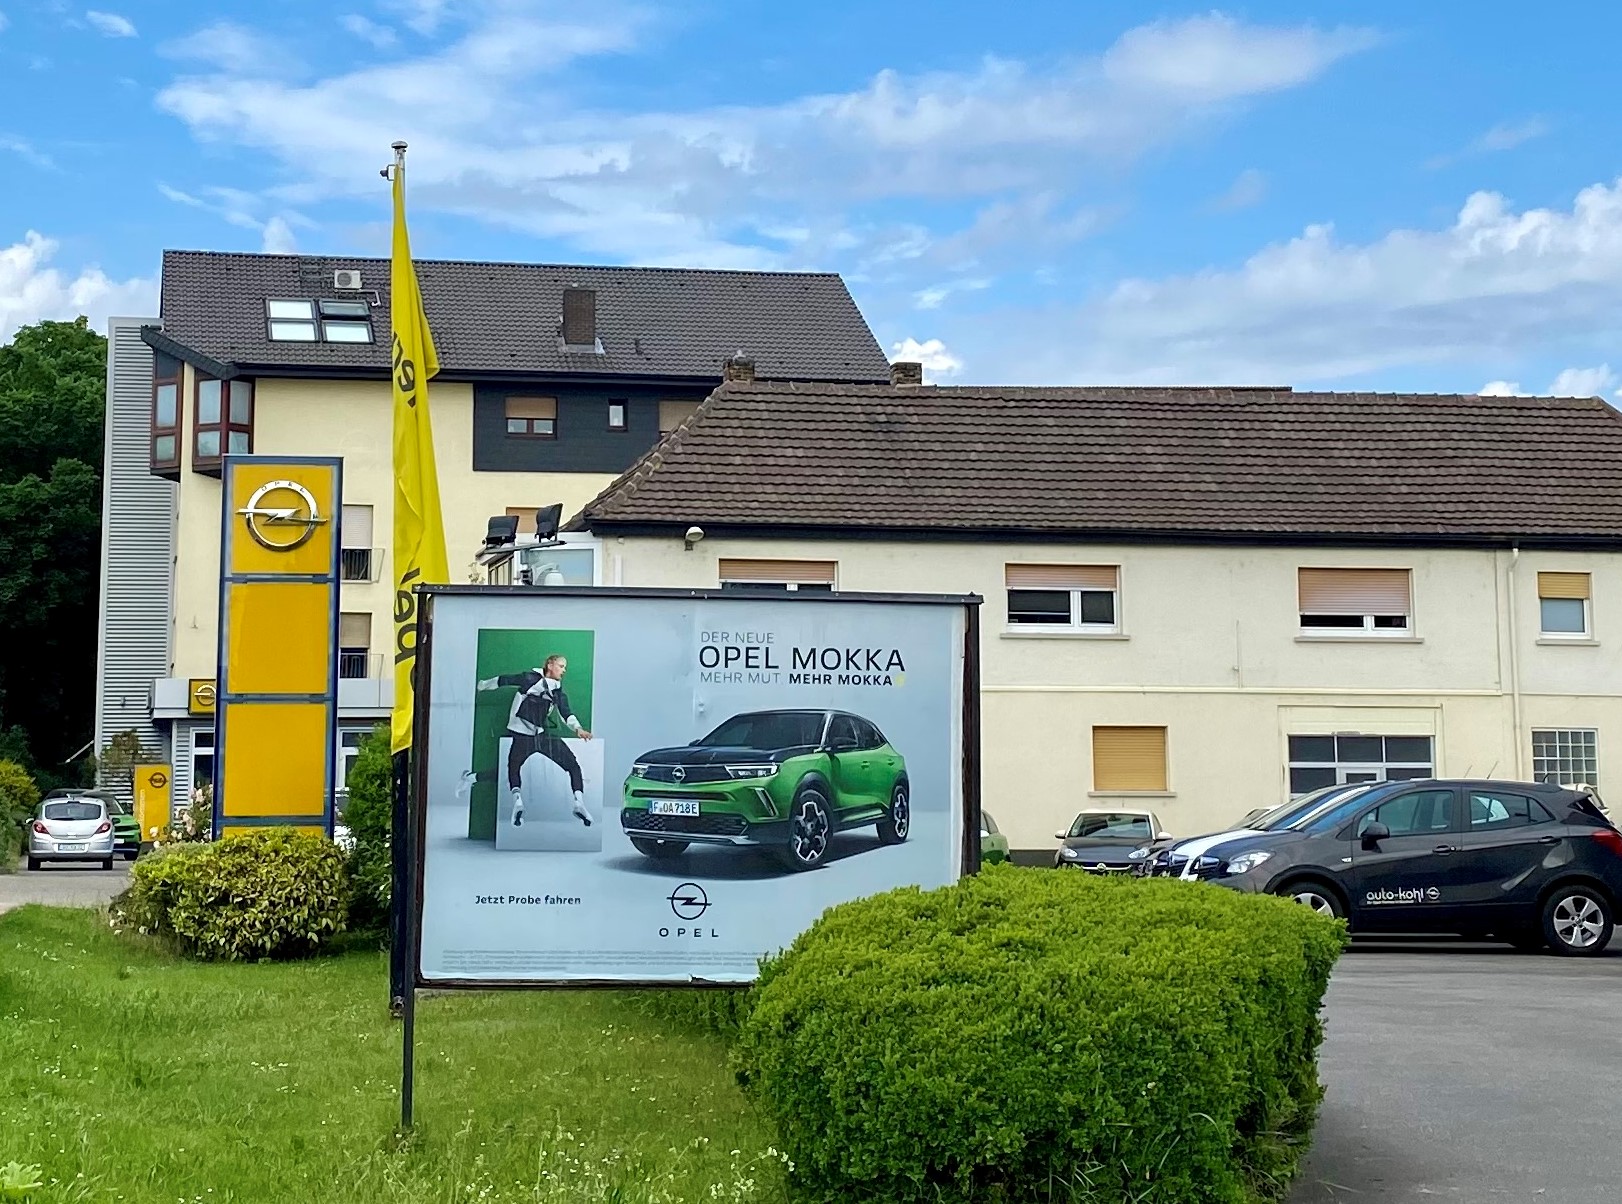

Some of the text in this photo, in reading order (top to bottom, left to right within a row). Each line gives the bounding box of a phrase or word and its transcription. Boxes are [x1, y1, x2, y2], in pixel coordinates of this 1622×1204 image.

[701, 631, 775, 644] DER NEUE
[699, 645, 905, 671] OPEL MOKKA
[700, 671, 743, 684] MEHR
[789, 673, 832, 685] MEHR
[838, 674, 893, 686] MOKKA
[475, 894, 581, 905] Jetzt Probe fahren
[1366, 886, 1424, 903] auto-kohl
[659, 927, 720, 938] OPEL
